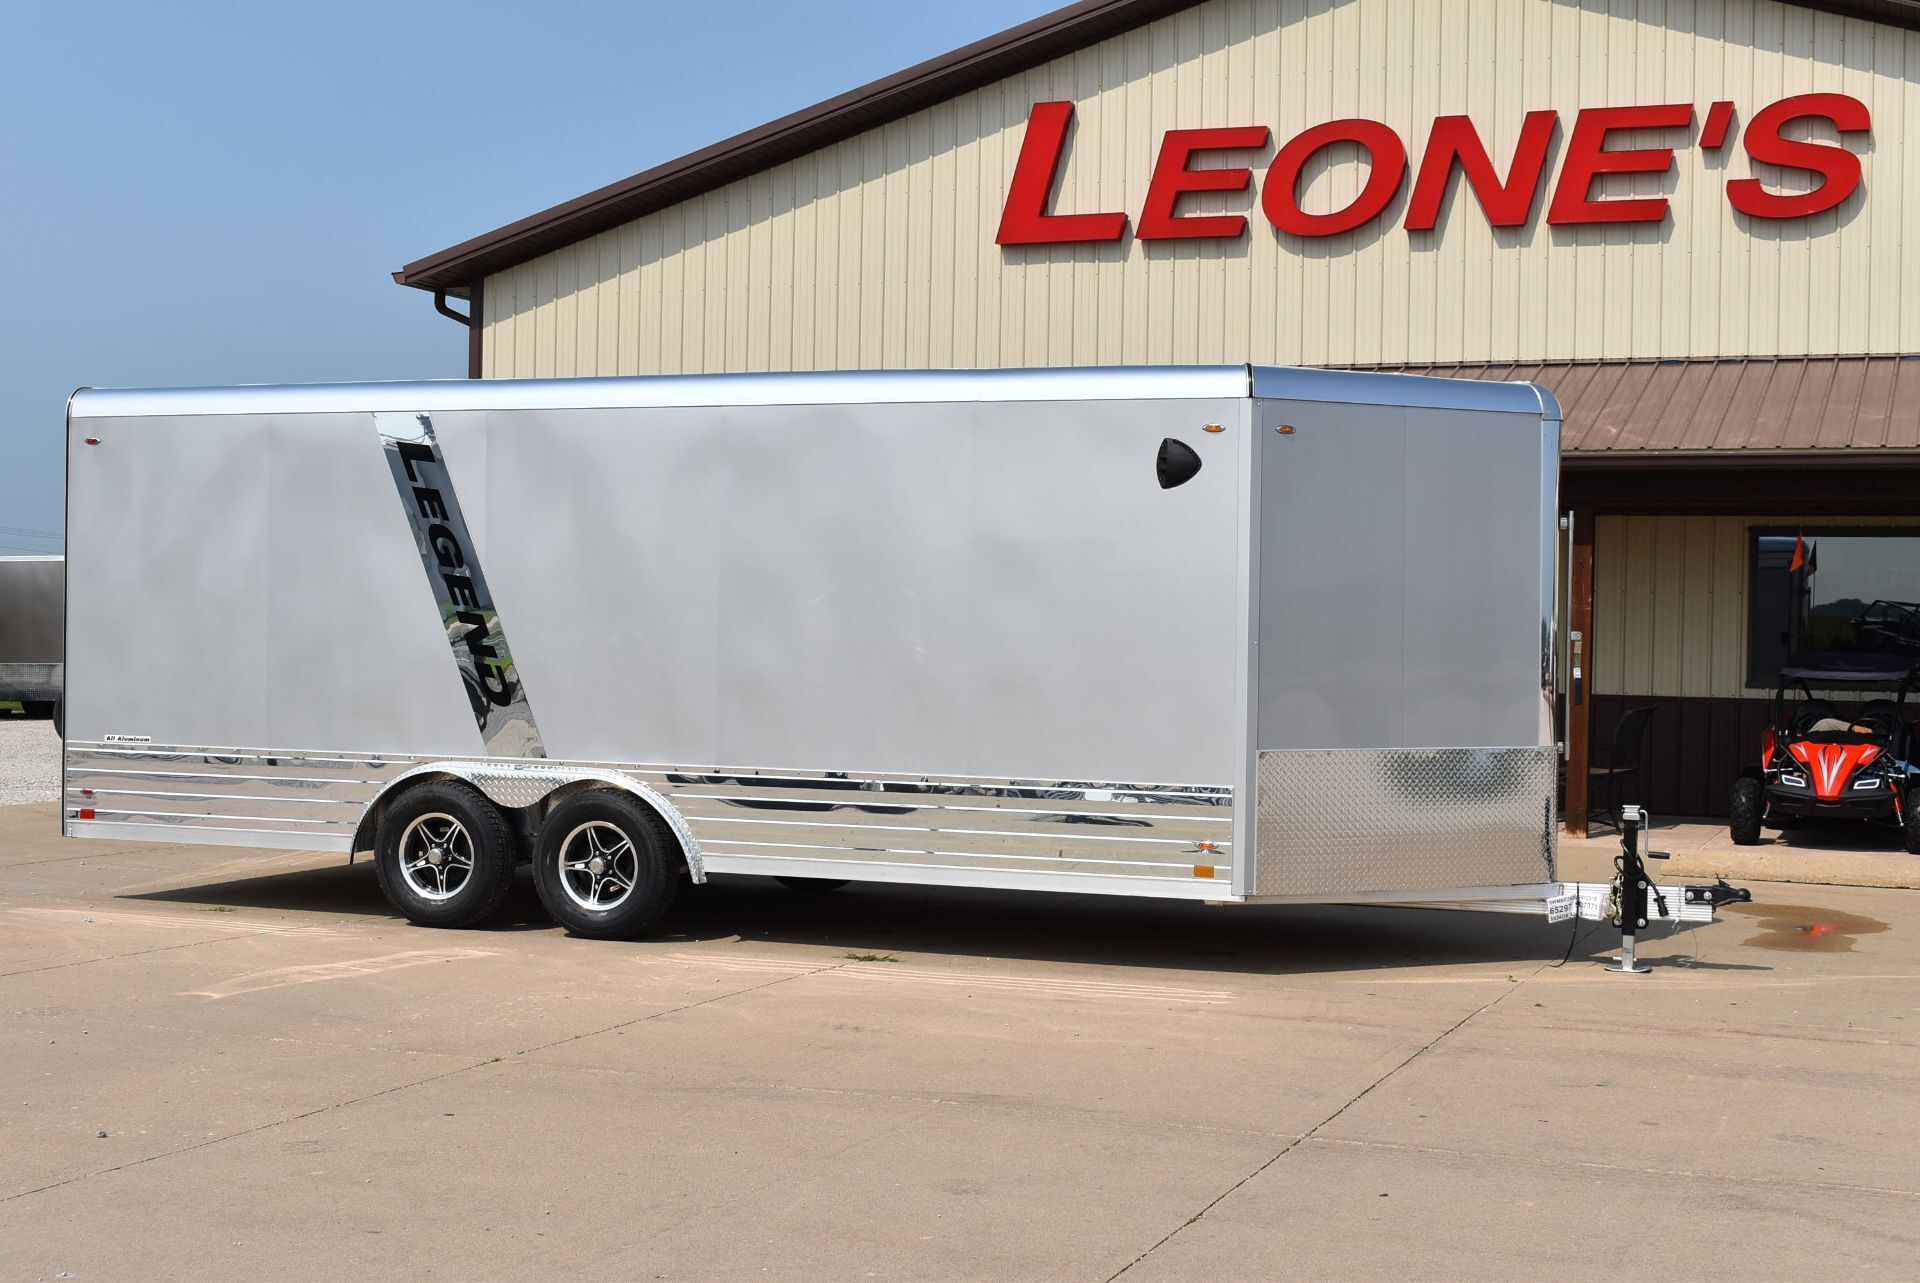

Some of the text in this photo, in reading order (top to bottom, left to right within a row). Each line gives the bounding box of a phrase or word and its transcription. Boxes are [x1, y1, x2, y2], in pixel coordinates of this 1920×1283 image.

[996, 92, 1871, 245] LEONE'S
[396, 440, 512, 707] LEGEND
[1549, 902, 1572, 915] 65297
